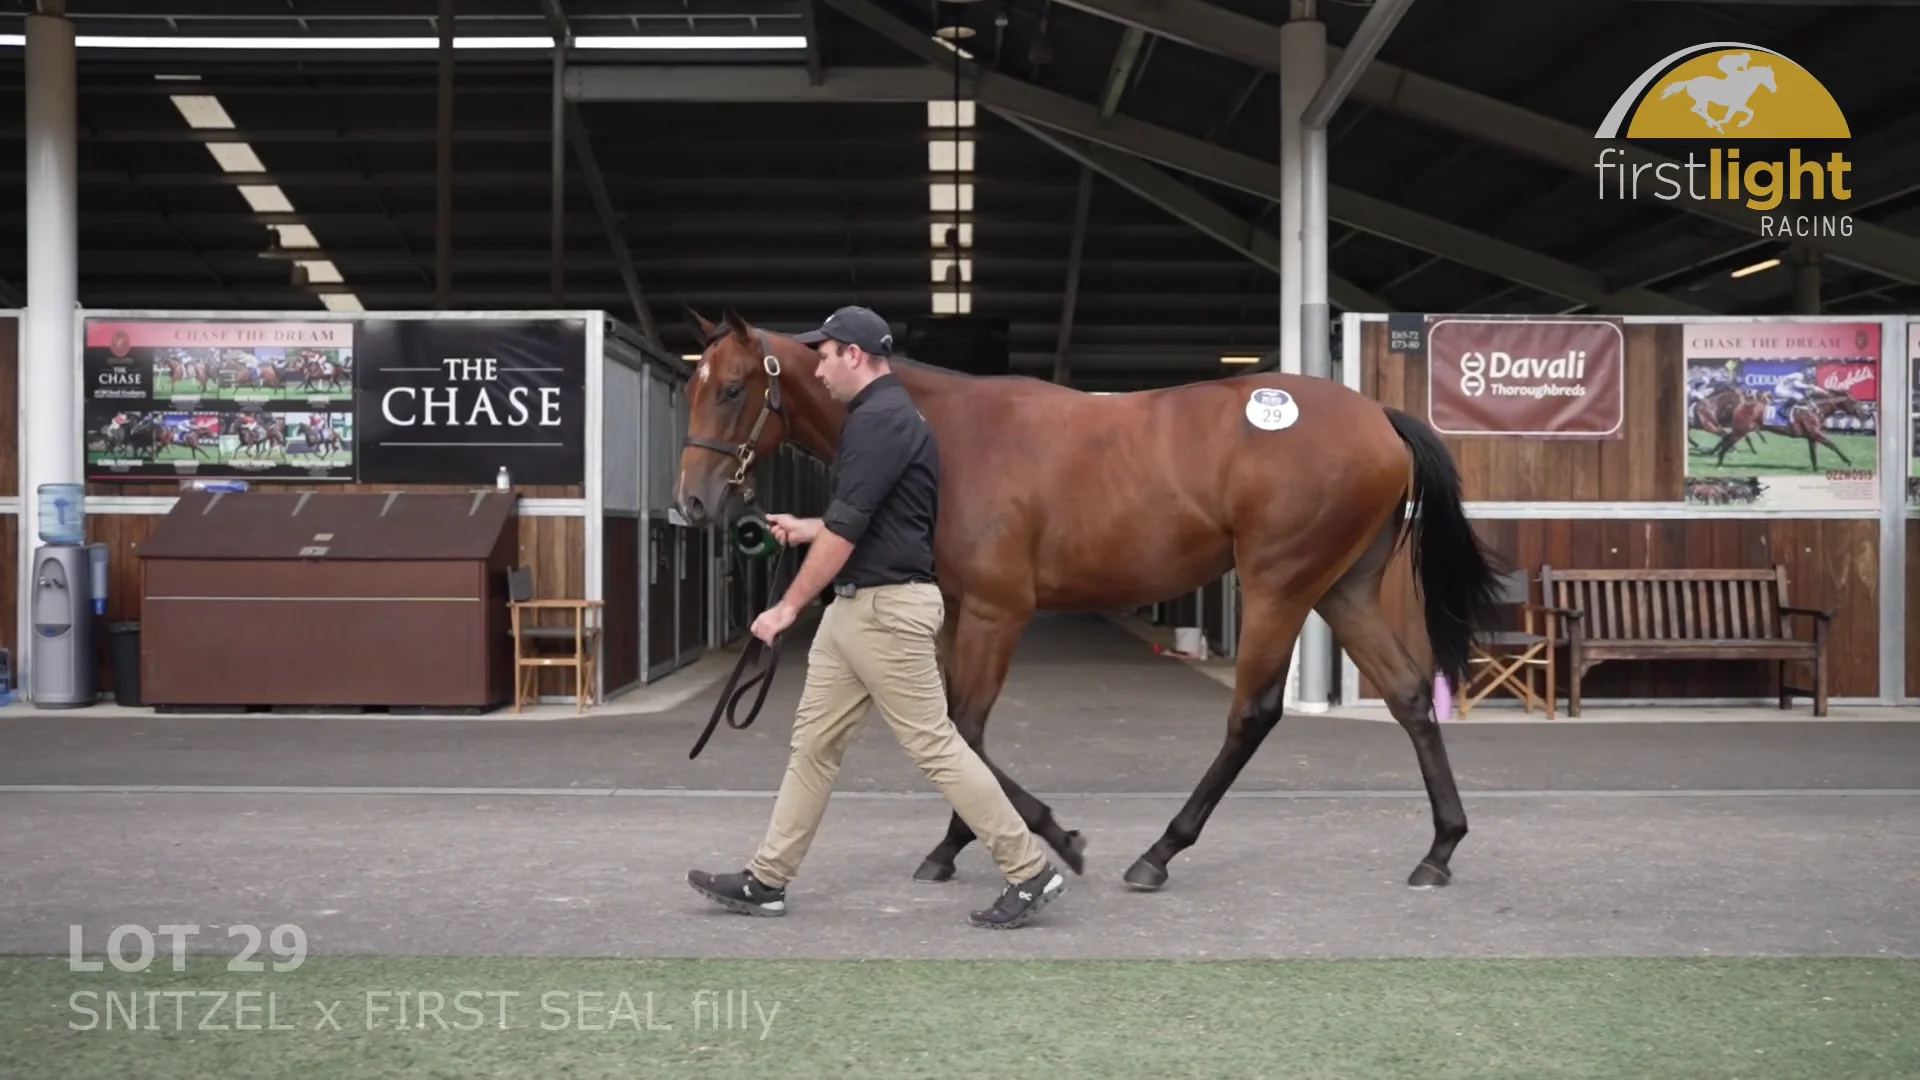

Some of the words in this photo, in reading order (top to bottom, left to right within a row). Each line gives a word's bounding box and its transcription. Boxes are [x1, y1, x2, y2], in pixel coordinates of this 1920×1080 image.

[174, 330, 228, 341] CHASE
[237, 330, 268, 341] THE
[275, 330, 335, 341] DREAM
[1692, 337, 1744, 349] CHASE
[1750, 337, 1779, 349] THE
[1784, 337, 1841, 349] DREAM
[443, 358, 498, 381] THE
[1489, 350, 1586, 379] Davali
[98, 373, 142, 385] CHASE
[1490, 383, 1586, 399] Thoroughbreds
[382, 386, 562, 426] CHASE
[1263, 408, 1282, 423] 29
